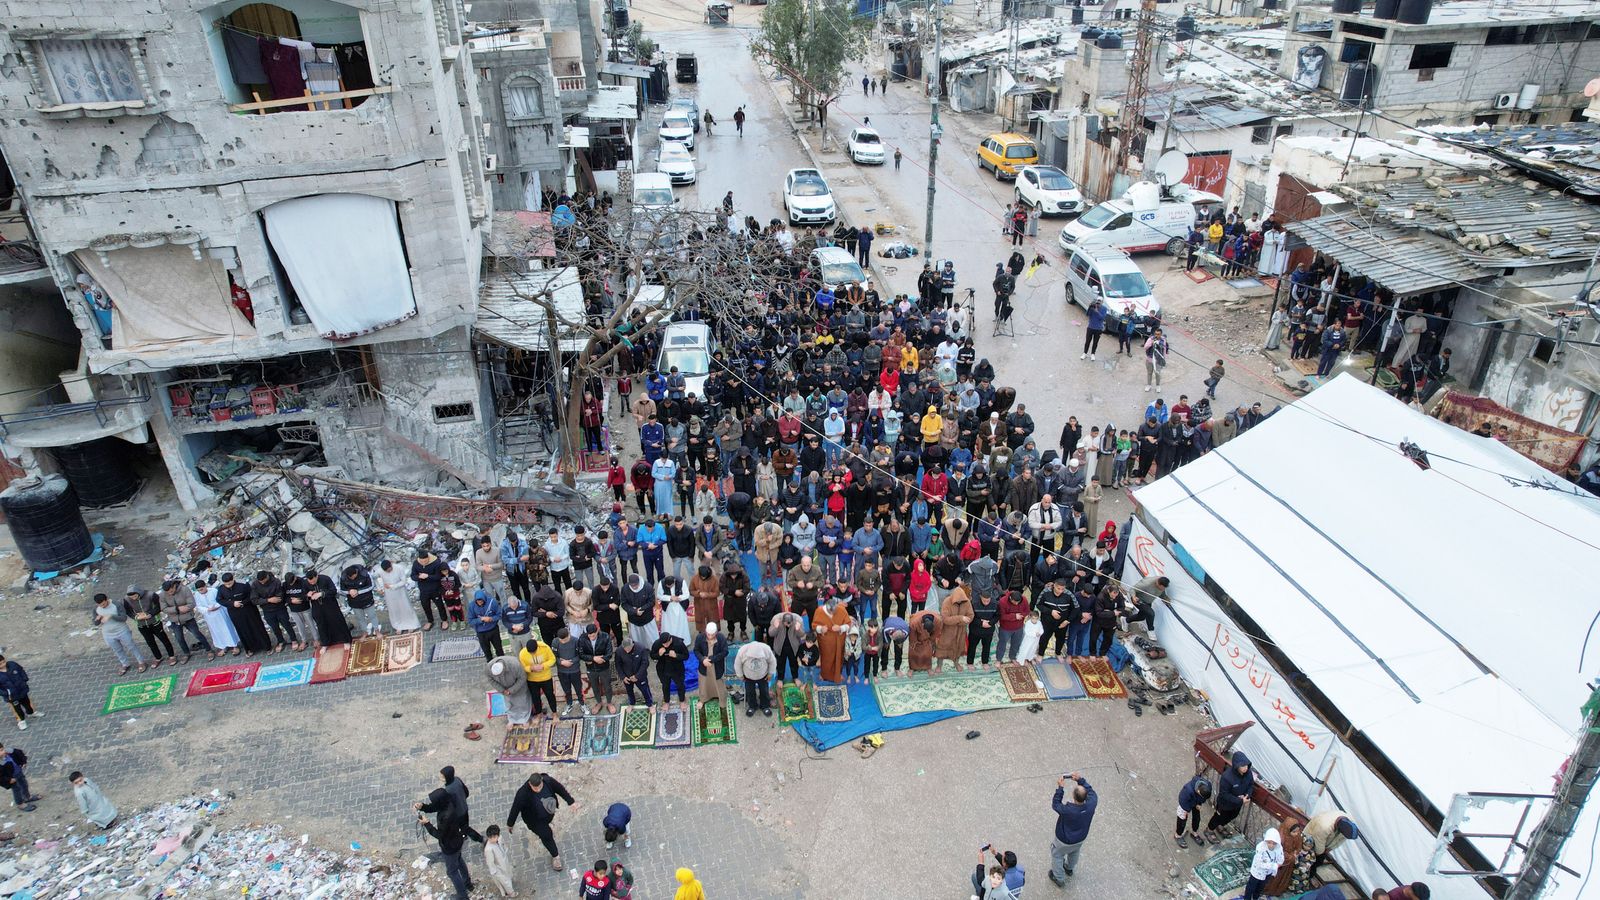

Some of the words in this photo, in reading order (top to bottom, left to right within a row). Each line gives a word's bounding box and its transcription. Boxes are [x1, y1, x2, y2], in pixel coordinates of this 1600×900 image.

[1140, 213, 1156, 221] GCS
[1118, 299, 1151, 312] TV
[1272, 698, 1316, 751] مسجد
